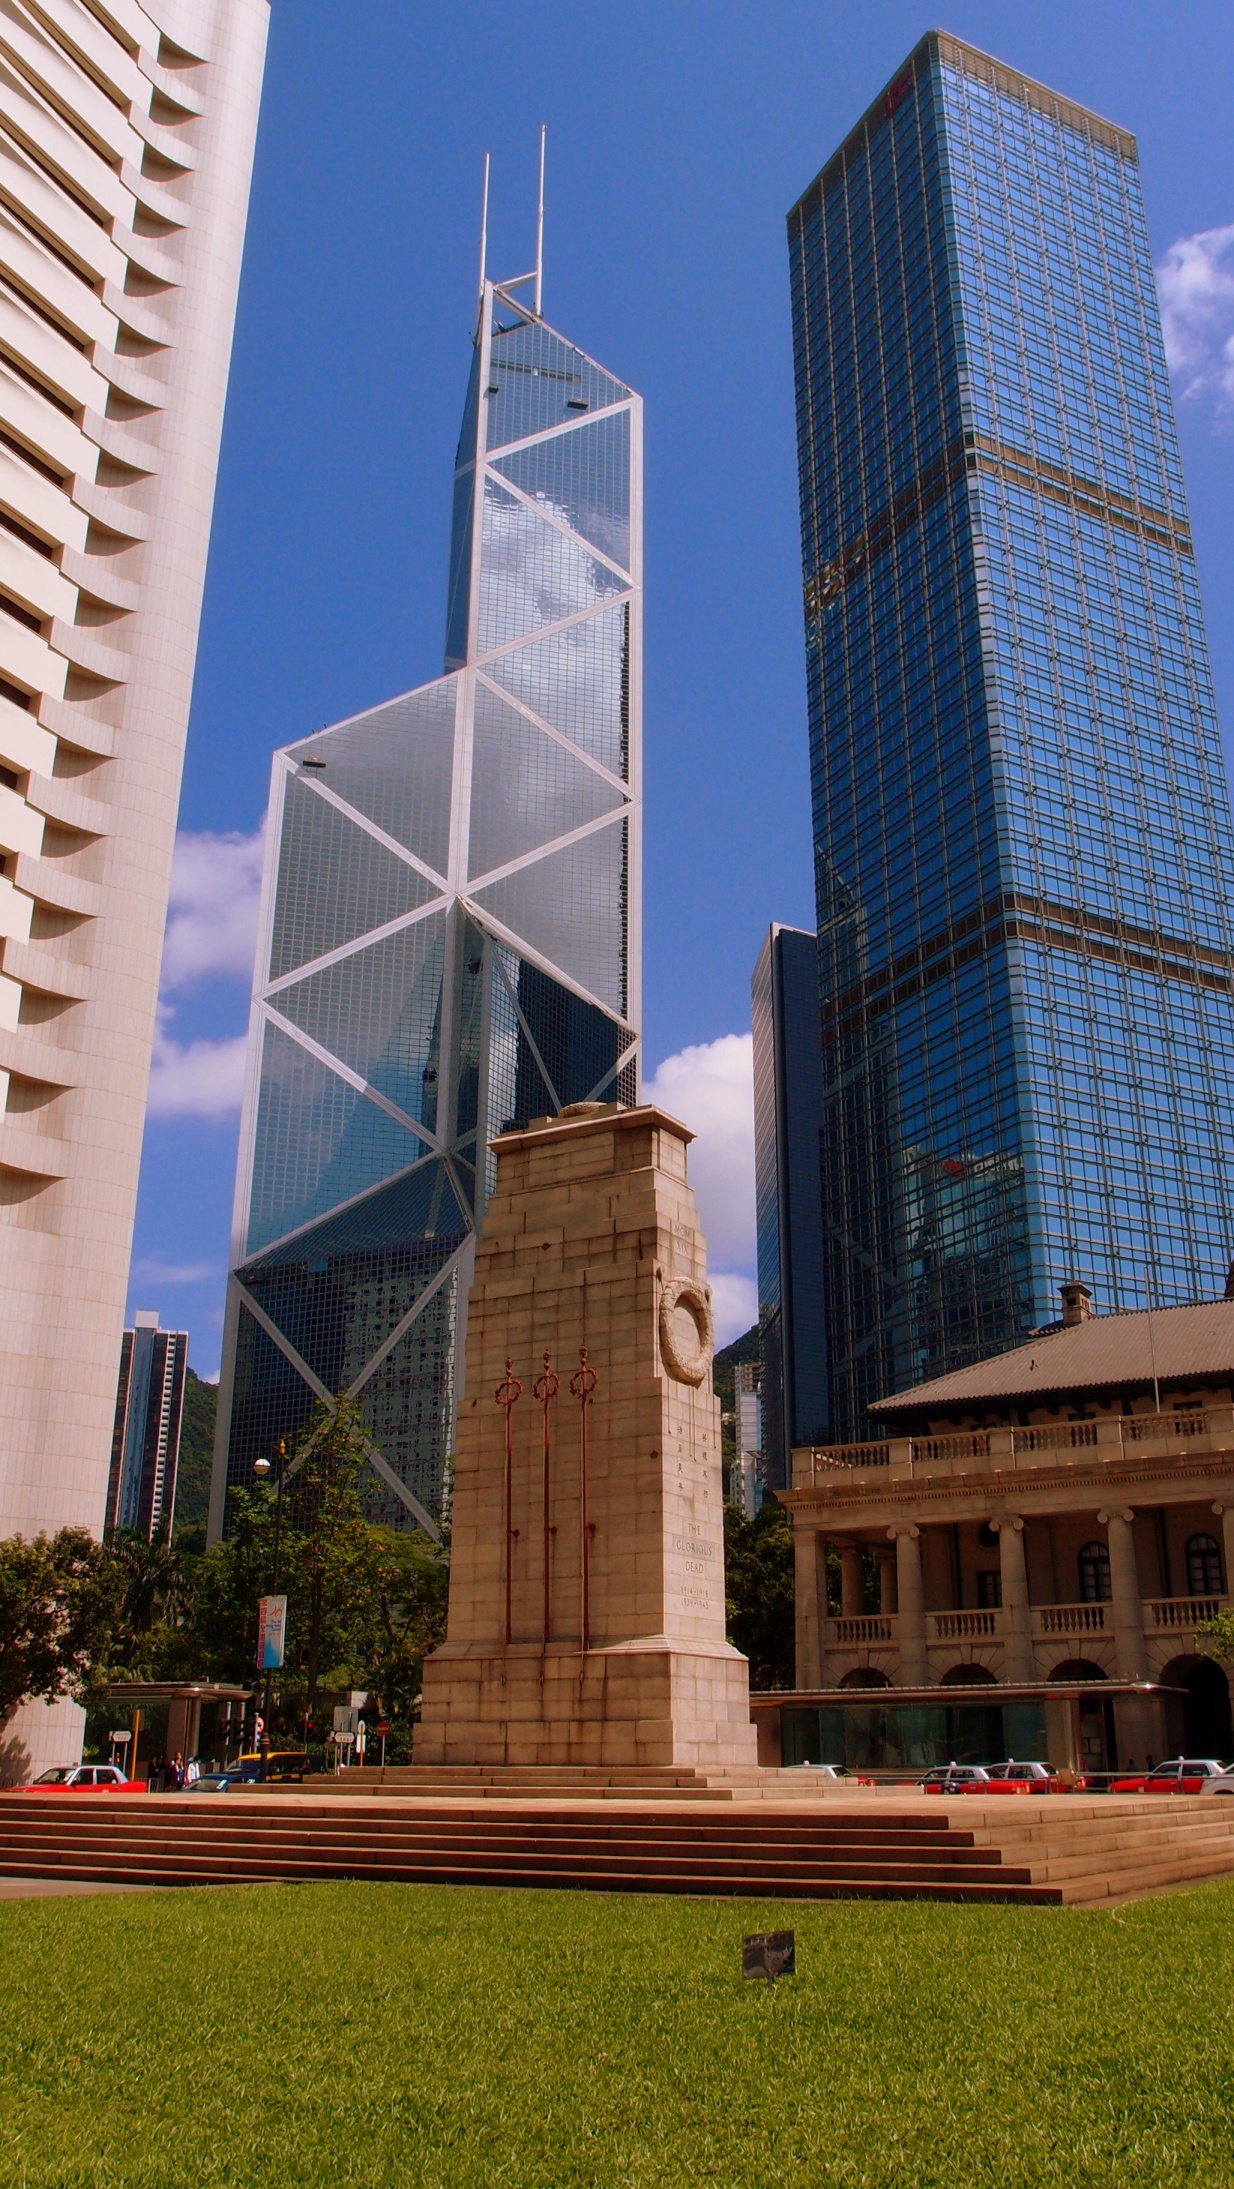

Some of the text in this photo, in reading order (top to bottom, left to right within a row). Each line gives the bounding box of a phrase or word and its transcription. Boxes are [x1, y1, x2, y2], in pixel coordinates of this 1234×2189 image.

[687, 1522, 701, 1536] THE
[676, 1539, 712, 1557] GLORIOUS
[685, 1560, 704, 1574] DEAD
